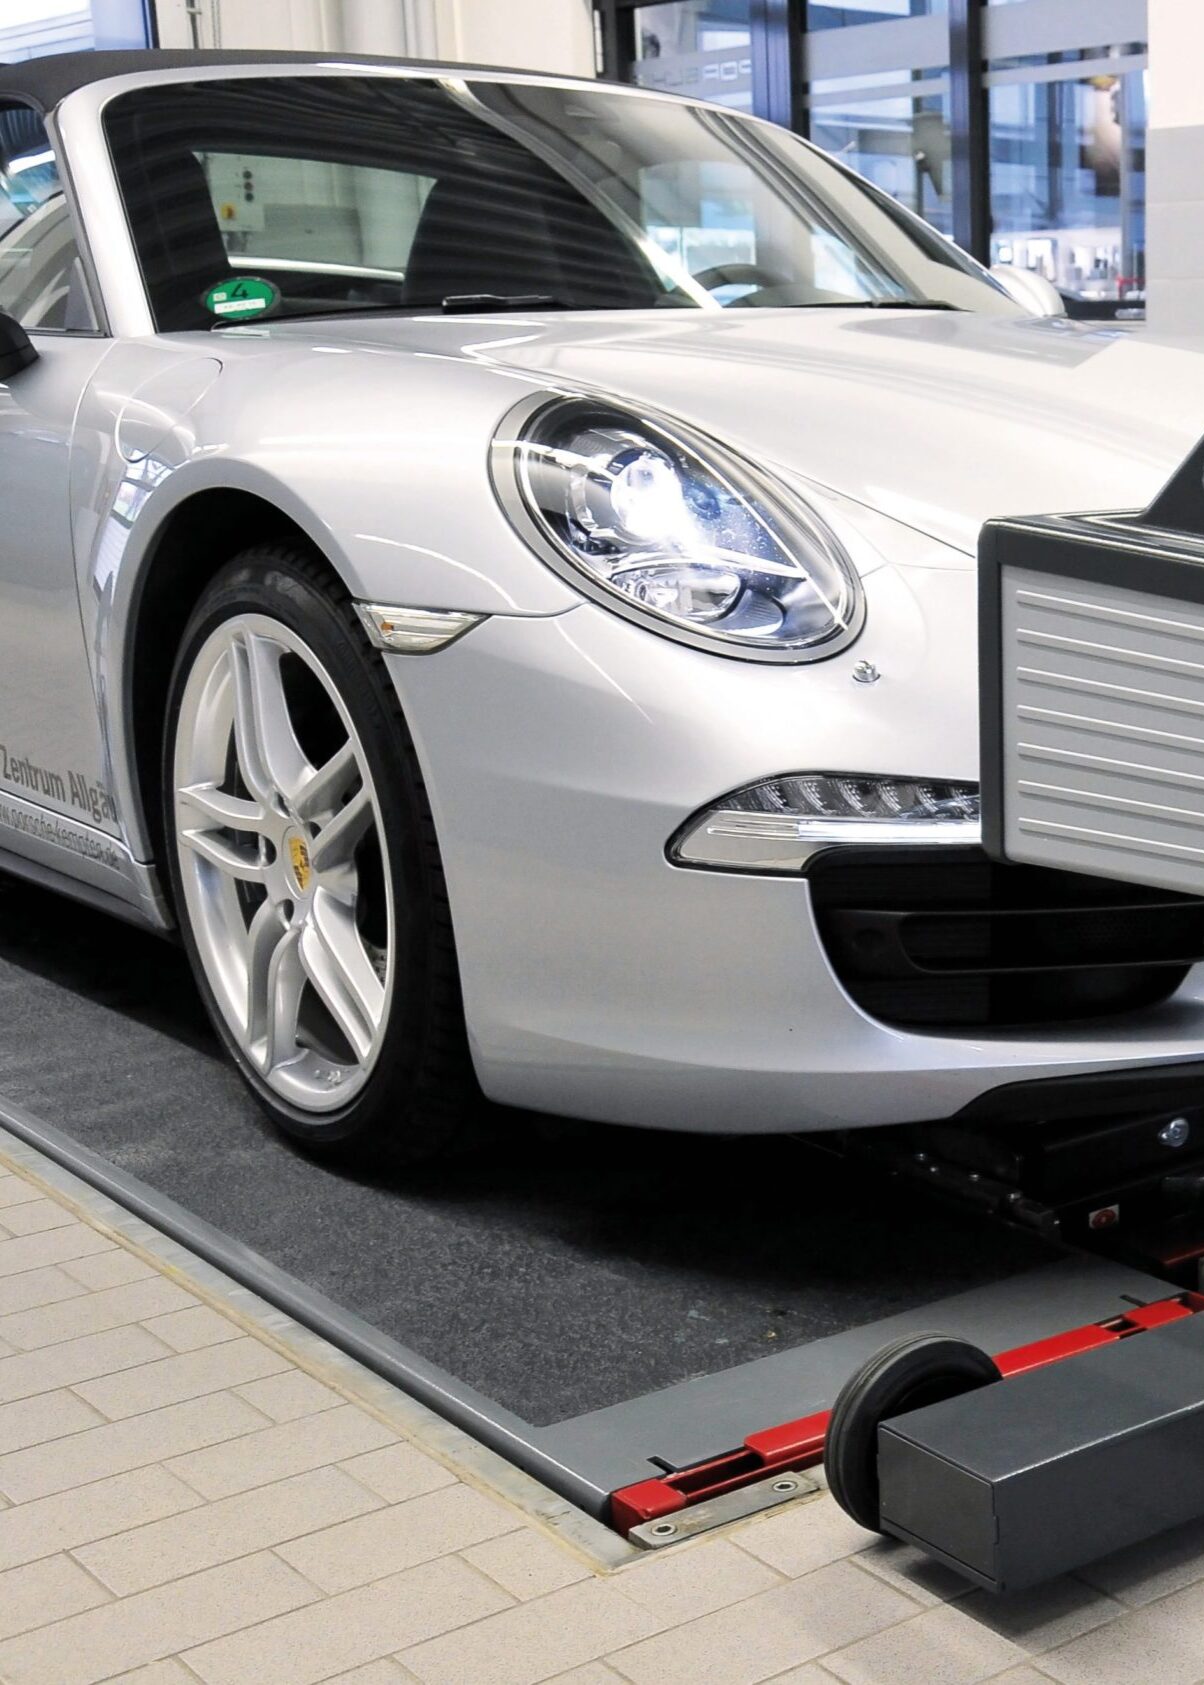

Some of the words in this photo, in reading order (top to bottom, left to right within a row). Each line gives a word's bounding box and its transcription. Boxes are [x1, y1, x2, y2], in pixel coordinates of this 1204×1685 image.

[231, 283, 248, 299] 4
[0, 744, 66, 802] Zentrum
[68, 770, 119, 824] Allgäu
